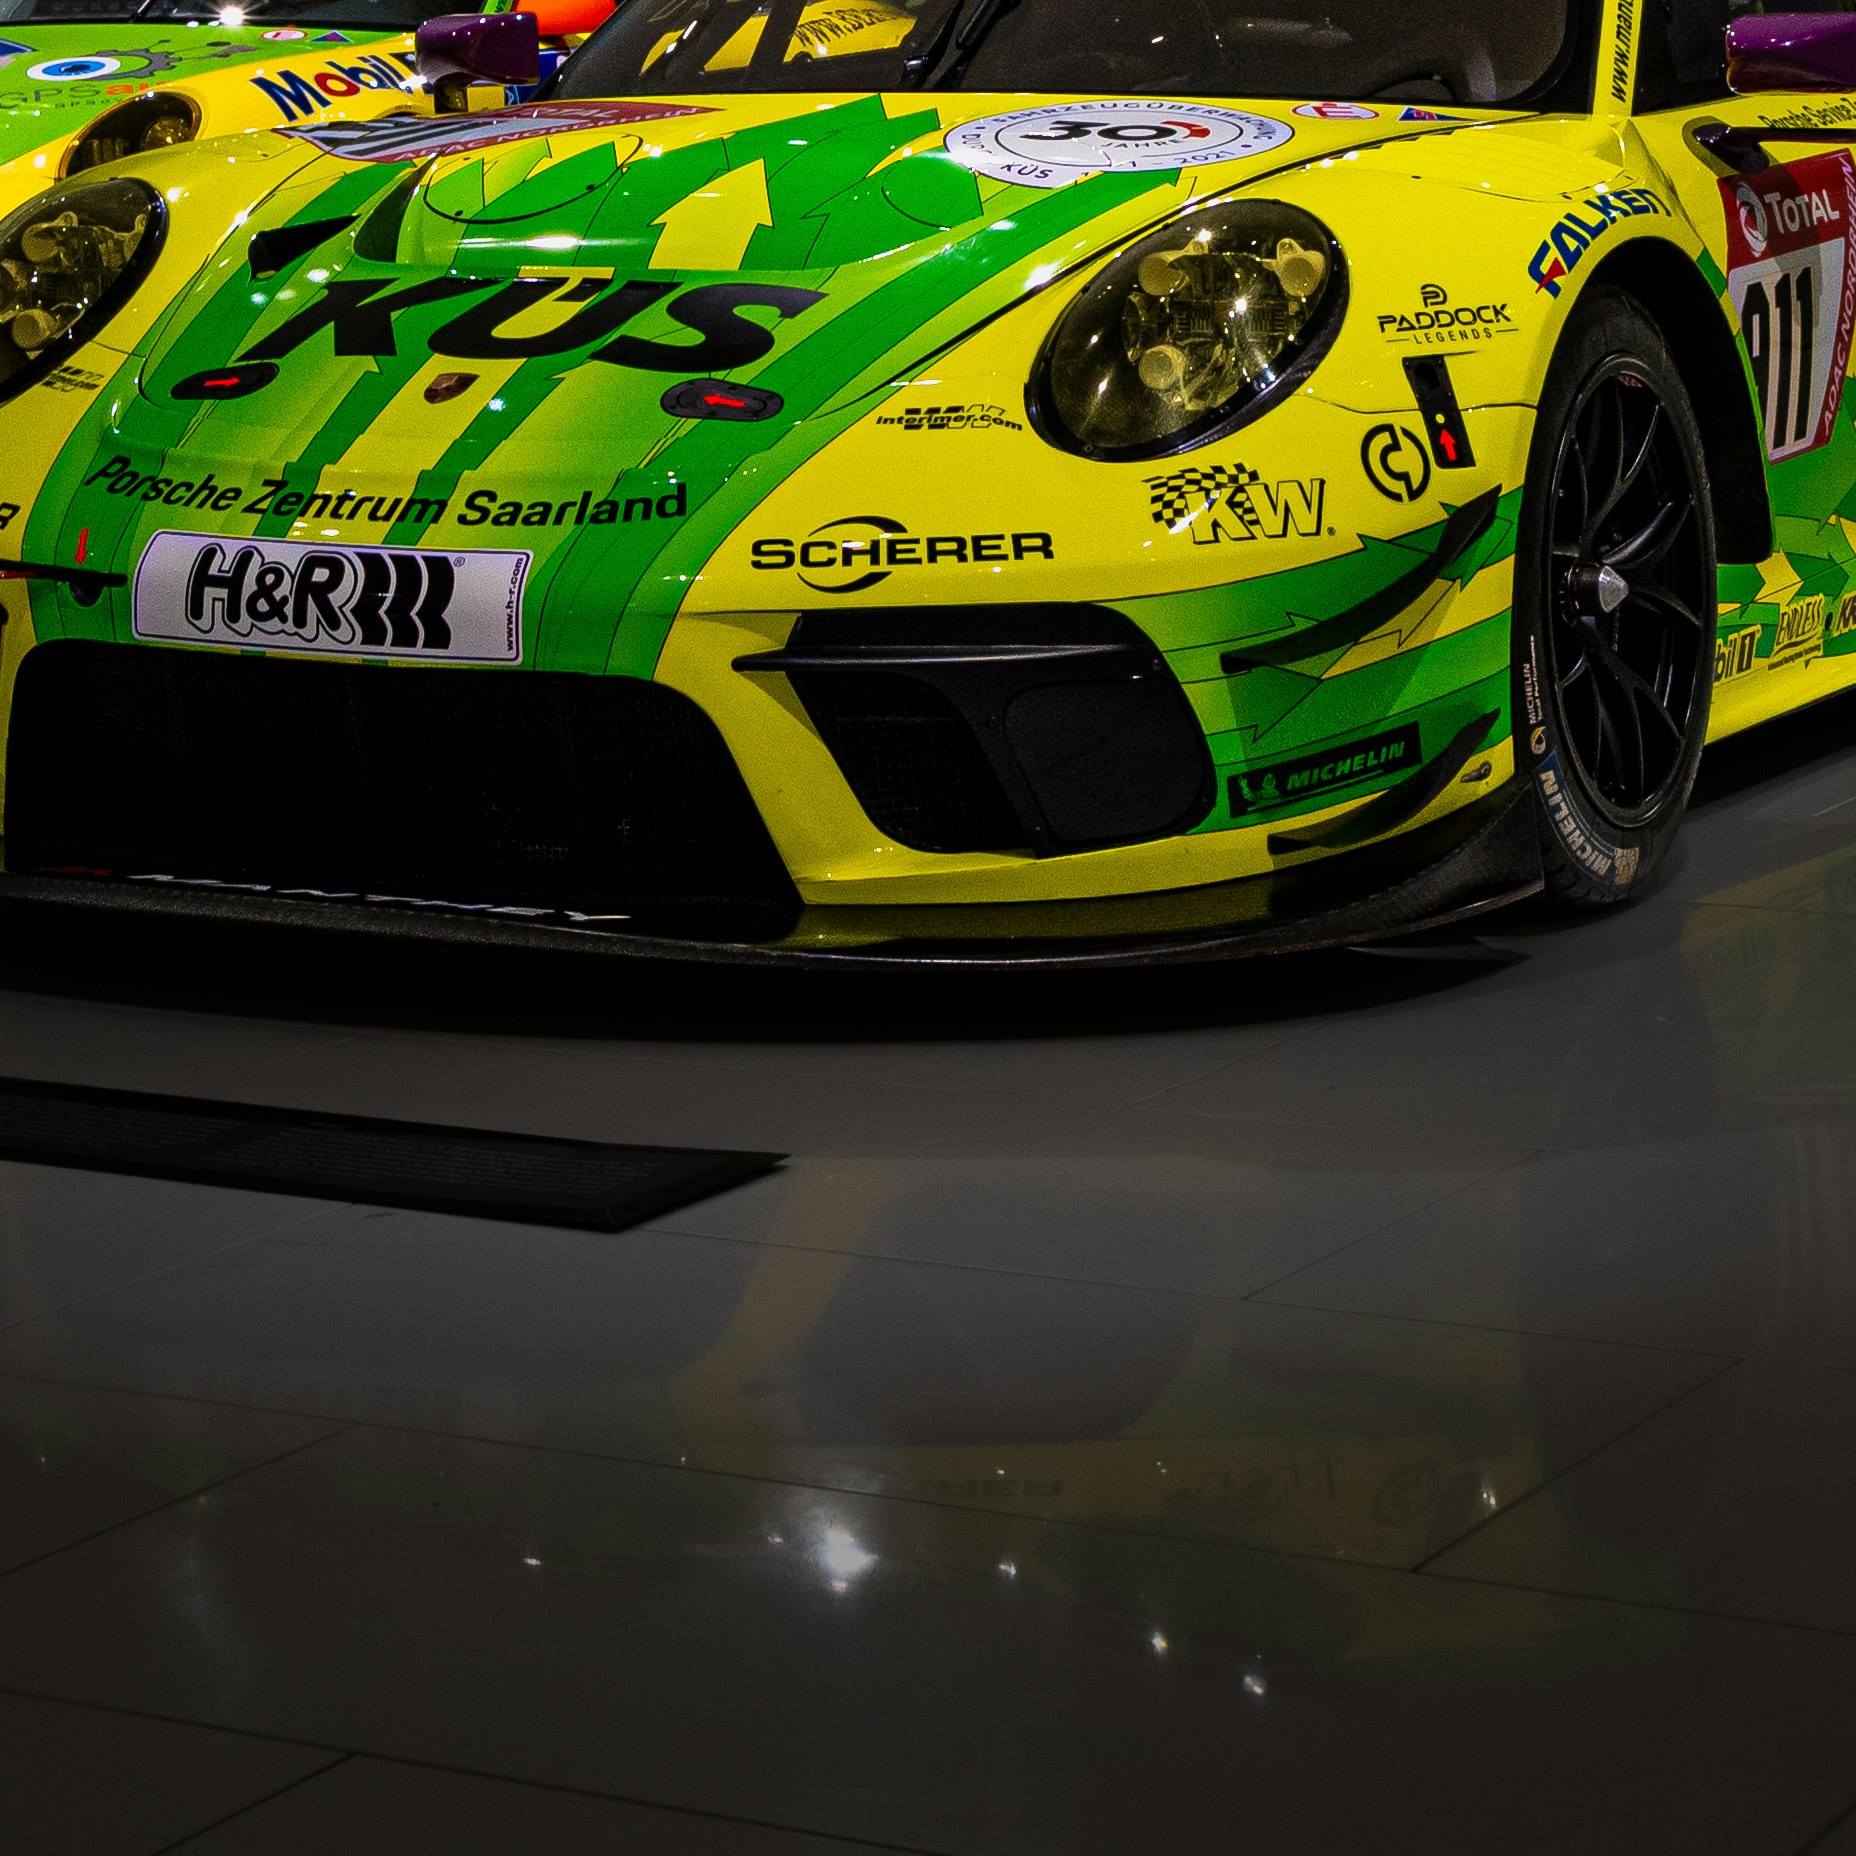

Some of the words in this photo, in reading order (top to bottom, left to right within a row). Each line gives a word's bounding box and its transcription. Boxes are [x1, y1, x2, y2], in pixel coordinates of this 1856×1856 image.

[249, 54, 413, 123] Mobil
[1000, 162, 1053, 180] KÜS
[1764, 189, 1841, 234] TOTAL
[236, 278, 829, 372] KÜS
[1377, 303, 1511, 333] PADDOCK
[1413, 327, 1493, 344] LEGENDS
[1824, 344, 1846, 437] ADAC
[875, 414, 1023, 432] interimer.com
[84, 455, 243, 511] Porsche
[242, 479, 447, 523] Zentrum
[457, 484, 687, 527] Saarland
[1184, 477, 1326, 545] KW
[750, 532, 1055, 570] SCHERER
[190, 545, 344, 633] H&R
[505, 557, 524, 652] www.h-r.com
[1776, 597, 1823, 646] ENDLESS
[1522, 663, 1537, 725] MICHELIN
[1286, 741, 1405, 791] MICHELIN
[1539, 768, 1613, 876] MICHELIN
